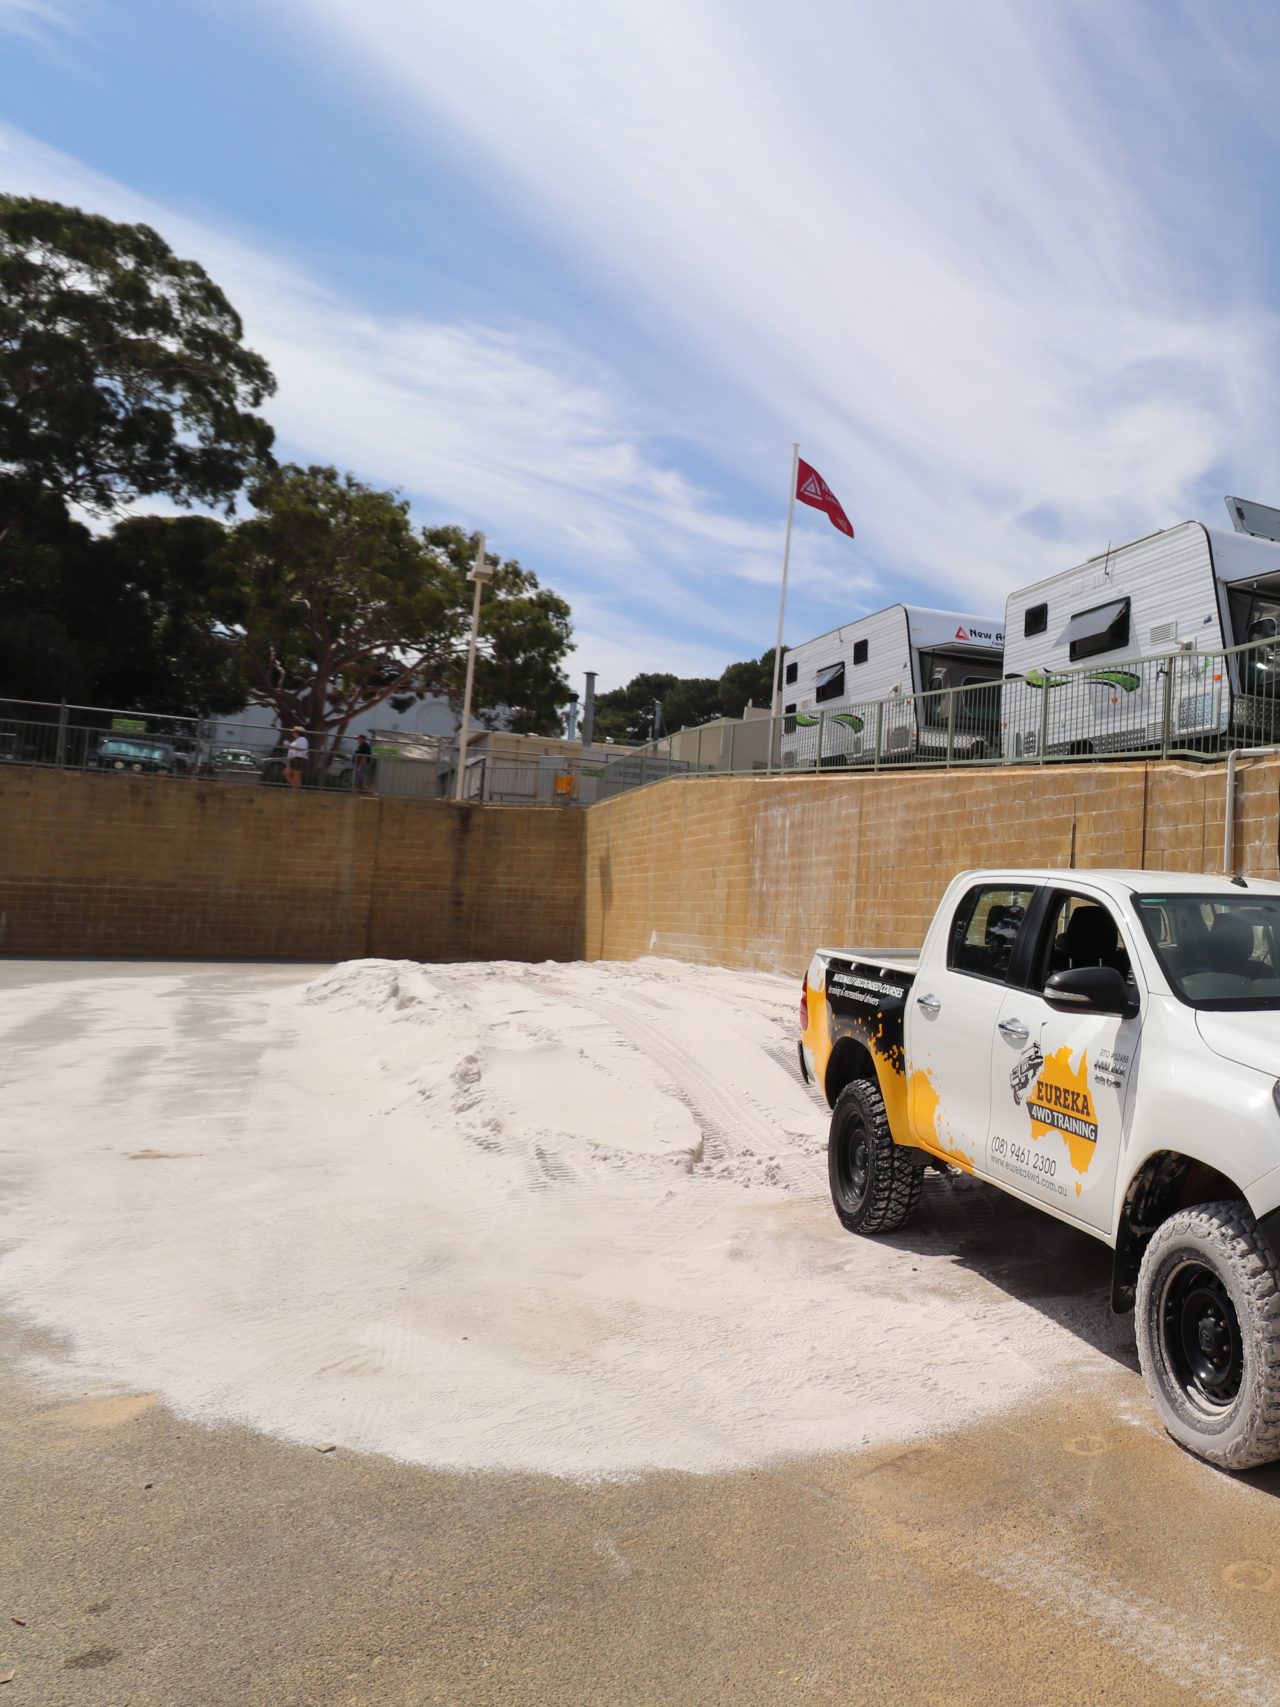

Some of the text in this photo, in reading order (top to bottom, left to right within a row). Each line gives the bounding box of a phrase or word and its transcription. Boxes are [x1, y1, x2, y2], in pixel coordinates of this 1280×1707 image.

[969, 629, 992, 640] New
[880, 984, 904, 998] COURSES
[1037, 1080, 1090, 1117] EUREKA
[1032, 1105, 1096, 1140] 4WD TRAINING
[991, 1136, 1056, 1177] (08) 9461 2300
[990, 1154, 1067, 1197] www.eureka4wd.com.au
